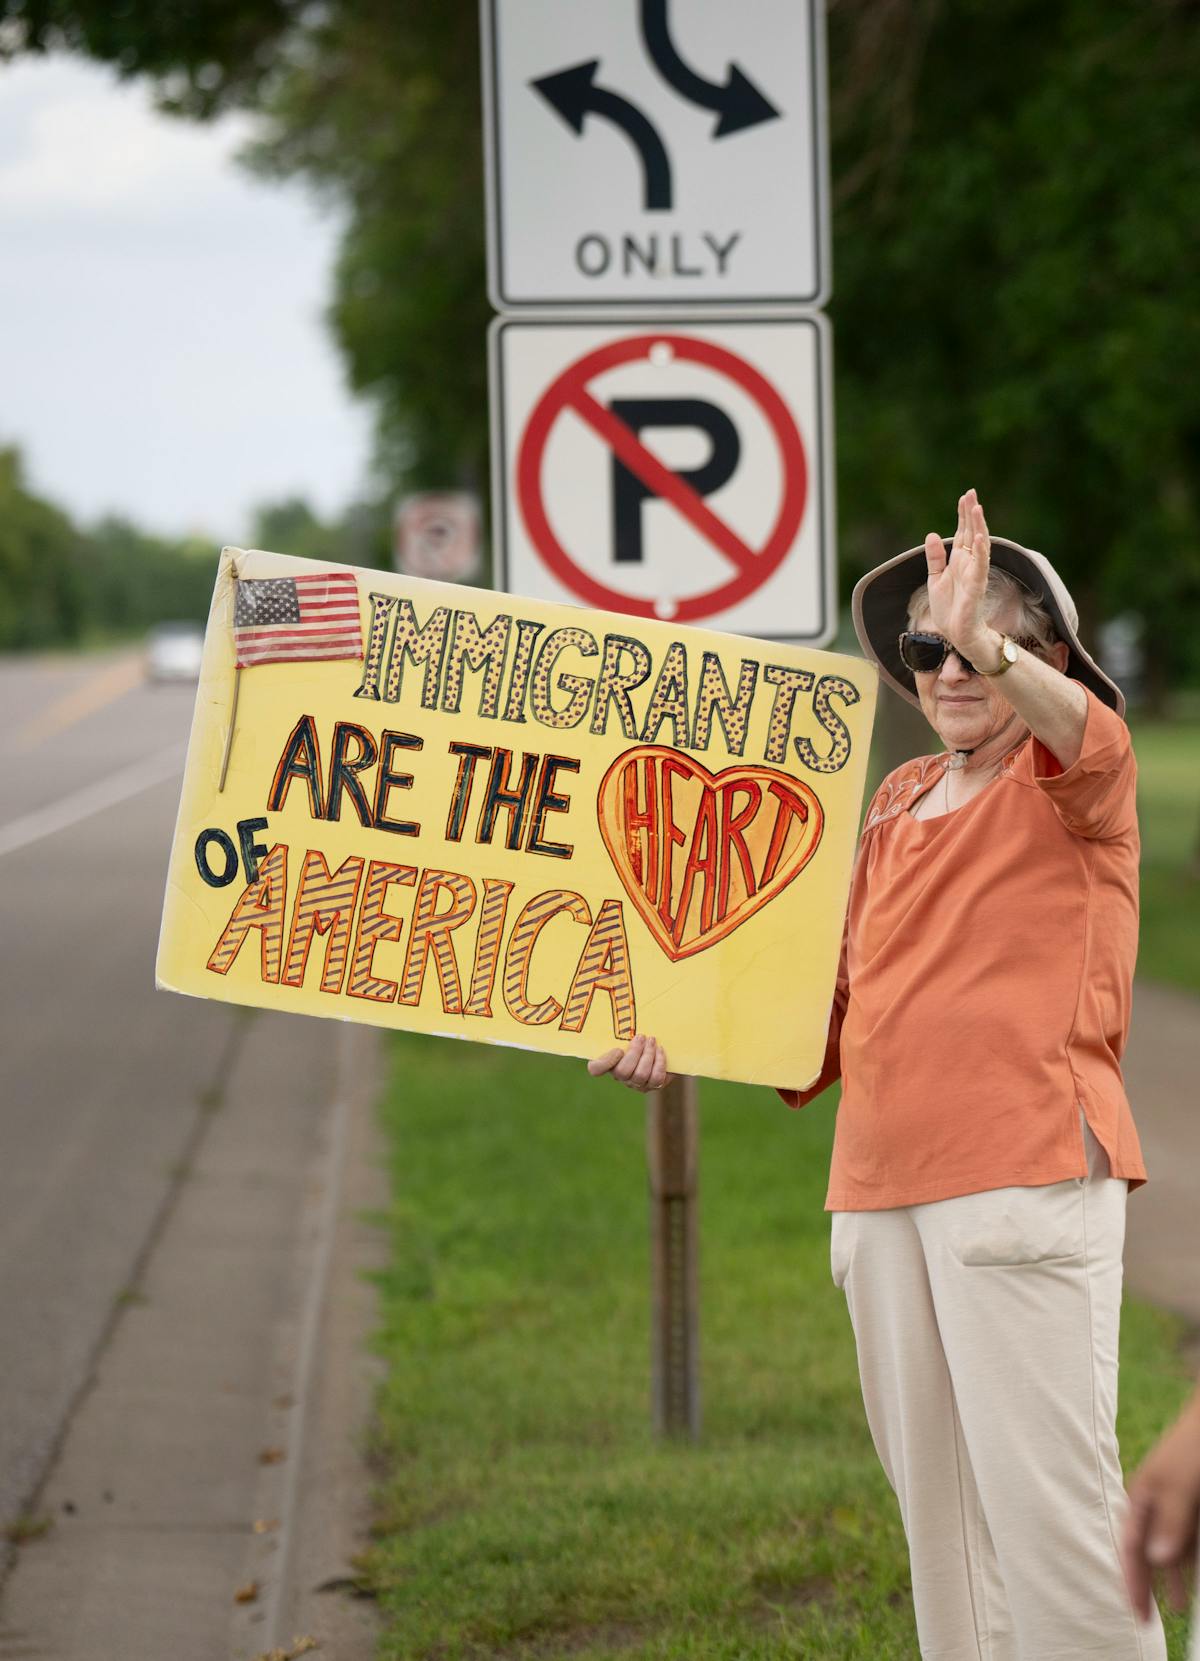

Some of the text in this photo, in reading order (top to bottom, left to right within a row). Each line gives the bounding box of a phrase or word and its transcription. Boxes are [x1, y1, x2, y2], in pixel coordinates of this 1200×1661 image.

[574, 232, 742, 278] ONLY
[352, 591, 861, 774] IMMIGRANTS
[194, 816, 637, 1040] OF AMERICA
[267, 715, 810, 952] ARE THE HEART
